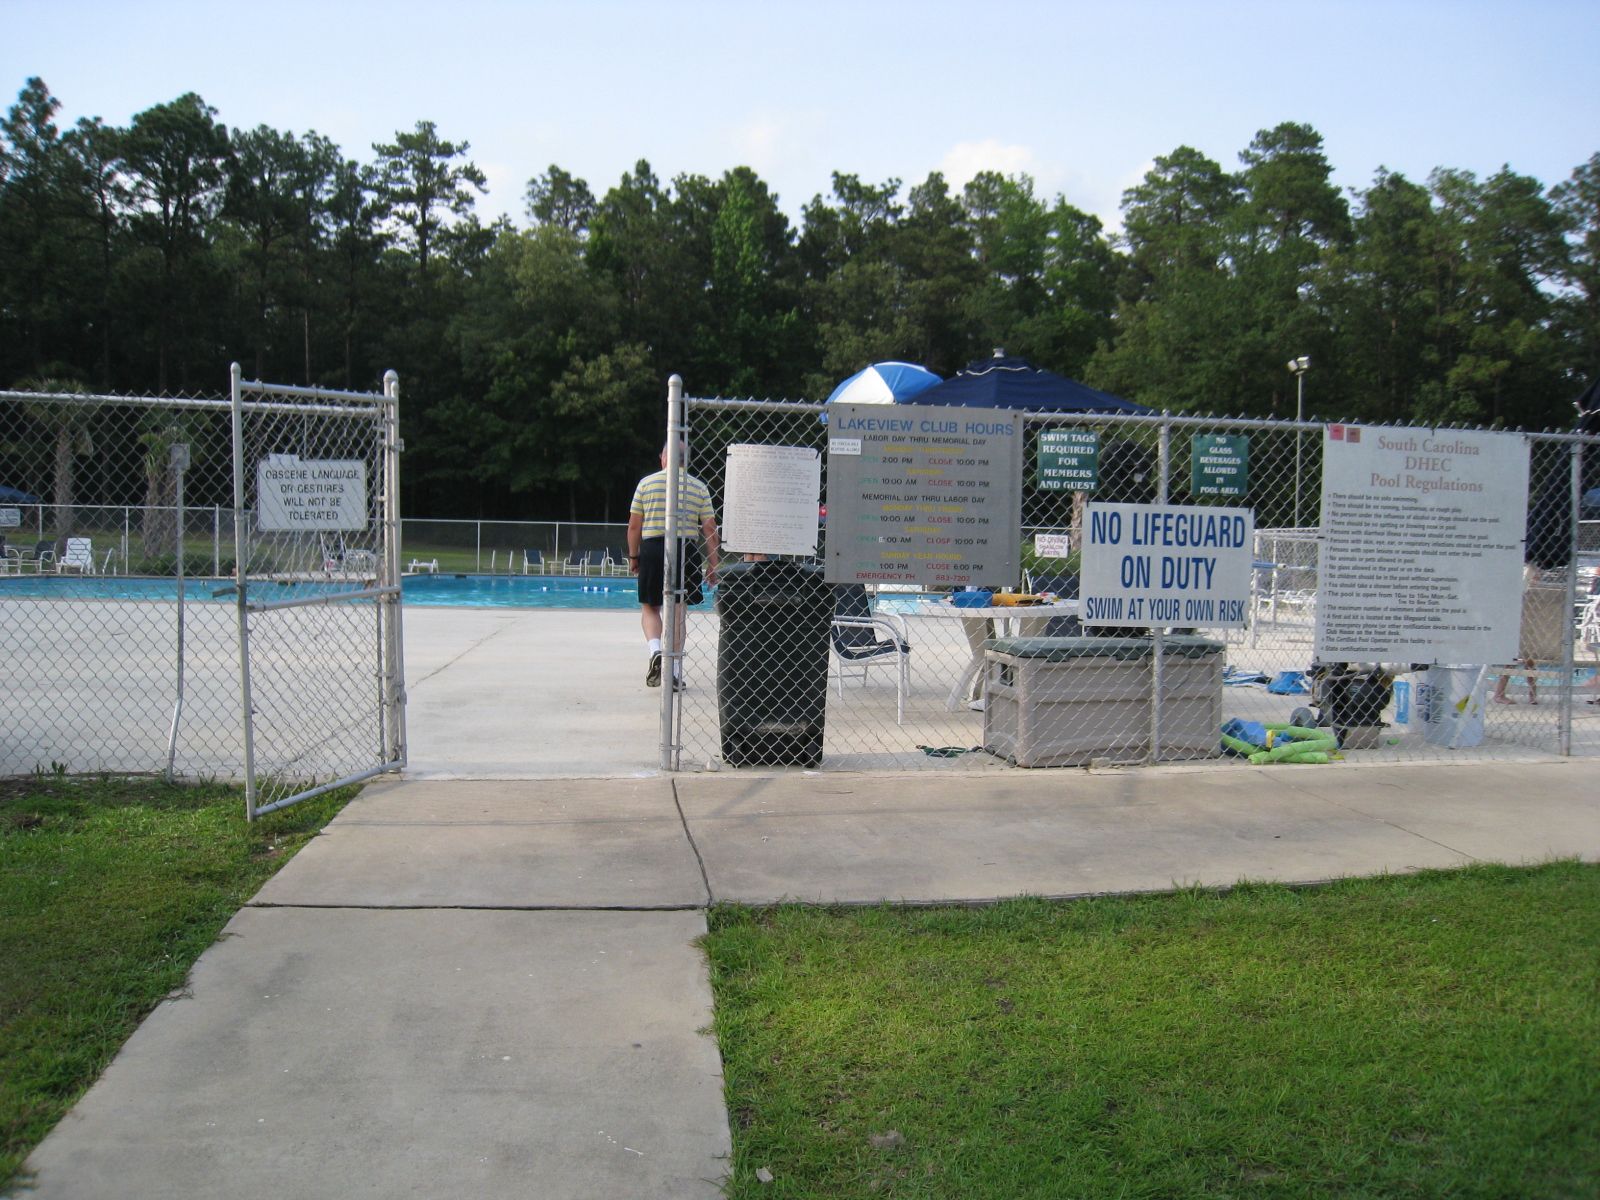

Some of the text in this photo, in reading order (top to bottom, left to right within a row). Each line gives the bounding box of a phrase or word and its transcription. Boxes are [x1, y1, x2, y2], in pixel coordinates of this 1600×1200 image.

[838, 418, 1014, 435] LAKEVIEW CLUB HOURS
[932, 437, 970, 445] MEMORIAL
[1071, 434, 1096, 442] TAGS
[1378, 435, 1480, 455] South Carolina
[1043, 446, 1094, 455] REQUIRED
[1058, 457, 1078, 466] FOR
[1405, 456, 1452, 472] DHEC
[266, 470, 359, 479] OBSCENE LANGUAGE
[1044, 469, 1092, 478] MEMBERS
[1203, 467, 1237, 475] ALLOWED
[1039, 481, 1096, 490] AND GUEST
[1370, 473, 1483, 494] Pool Regulations
[280, 484, 344, 493] OR GESTURES
[284, 498, 341, 506] WILL NOT BE
[862, 493, 900, 502] MEMORIAL
[288, 511, 338, 520] TOLERATED
[1092, 511, 1245, 548] NO LIFEGUARD
[1121, 555, 1216, 590] ON DUTY
[1086, 597, 1244, 622] SWIM AT YOUR OWN RISK
